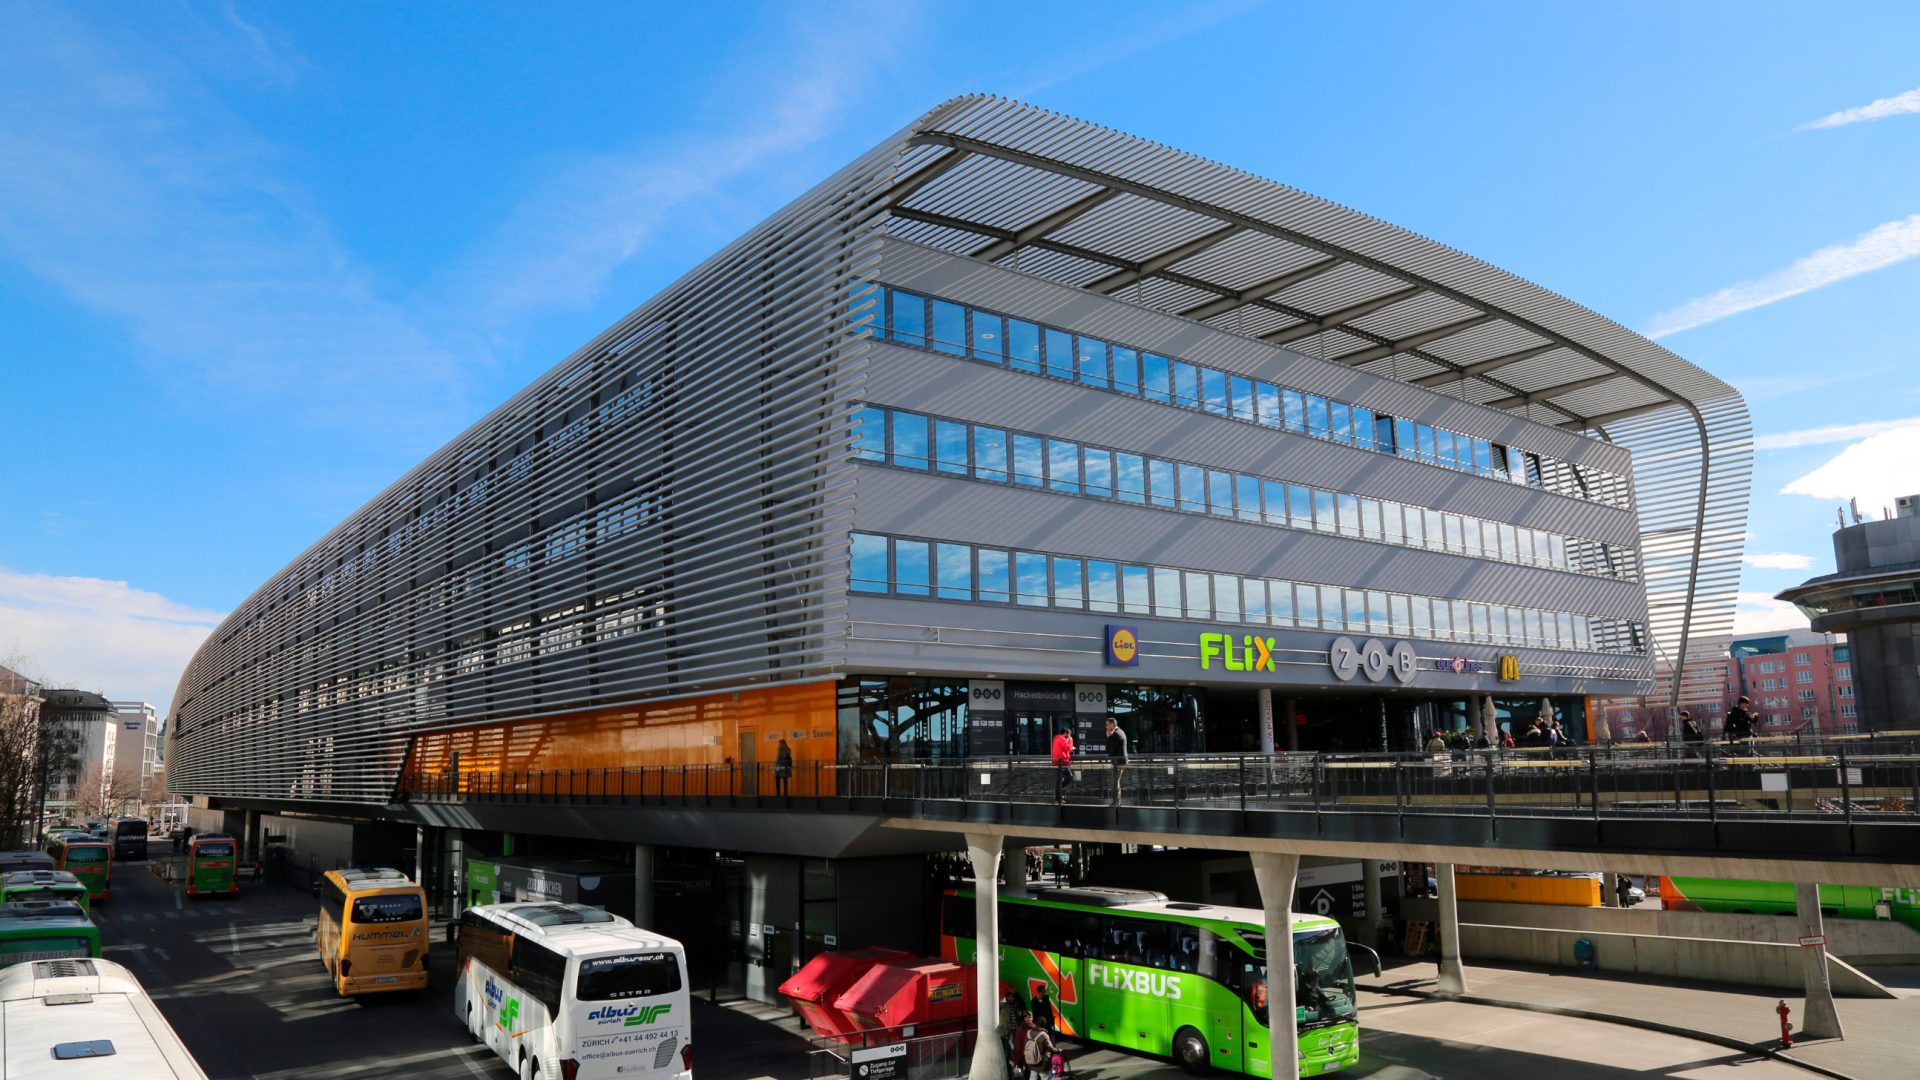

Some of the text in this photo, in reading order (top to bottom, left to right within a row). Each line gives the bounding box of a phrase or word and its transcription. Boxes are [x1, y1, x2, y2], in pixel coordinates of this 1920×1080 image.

[1337, 646, 1412, 674] ZOB
[1014, 690, 1061, 700] Hackerbrücke
[1881, 887, 1920, 905] FLi
[1090, 963, 1182, 1000] FLiXBUS
[588, 1006, 638, 1020] albus
[597, 1017, 622, 1026] zürich
[582, 1039, 610, 1048] ZÜRICH
[645, 1032, 658, 1040] 492
[670, 1029, 679, 1037] 13
[582, 1046, 657, 1061] office@albus-zuerich.ch
[870, 1066, 895, 1075] Tiefgarage
